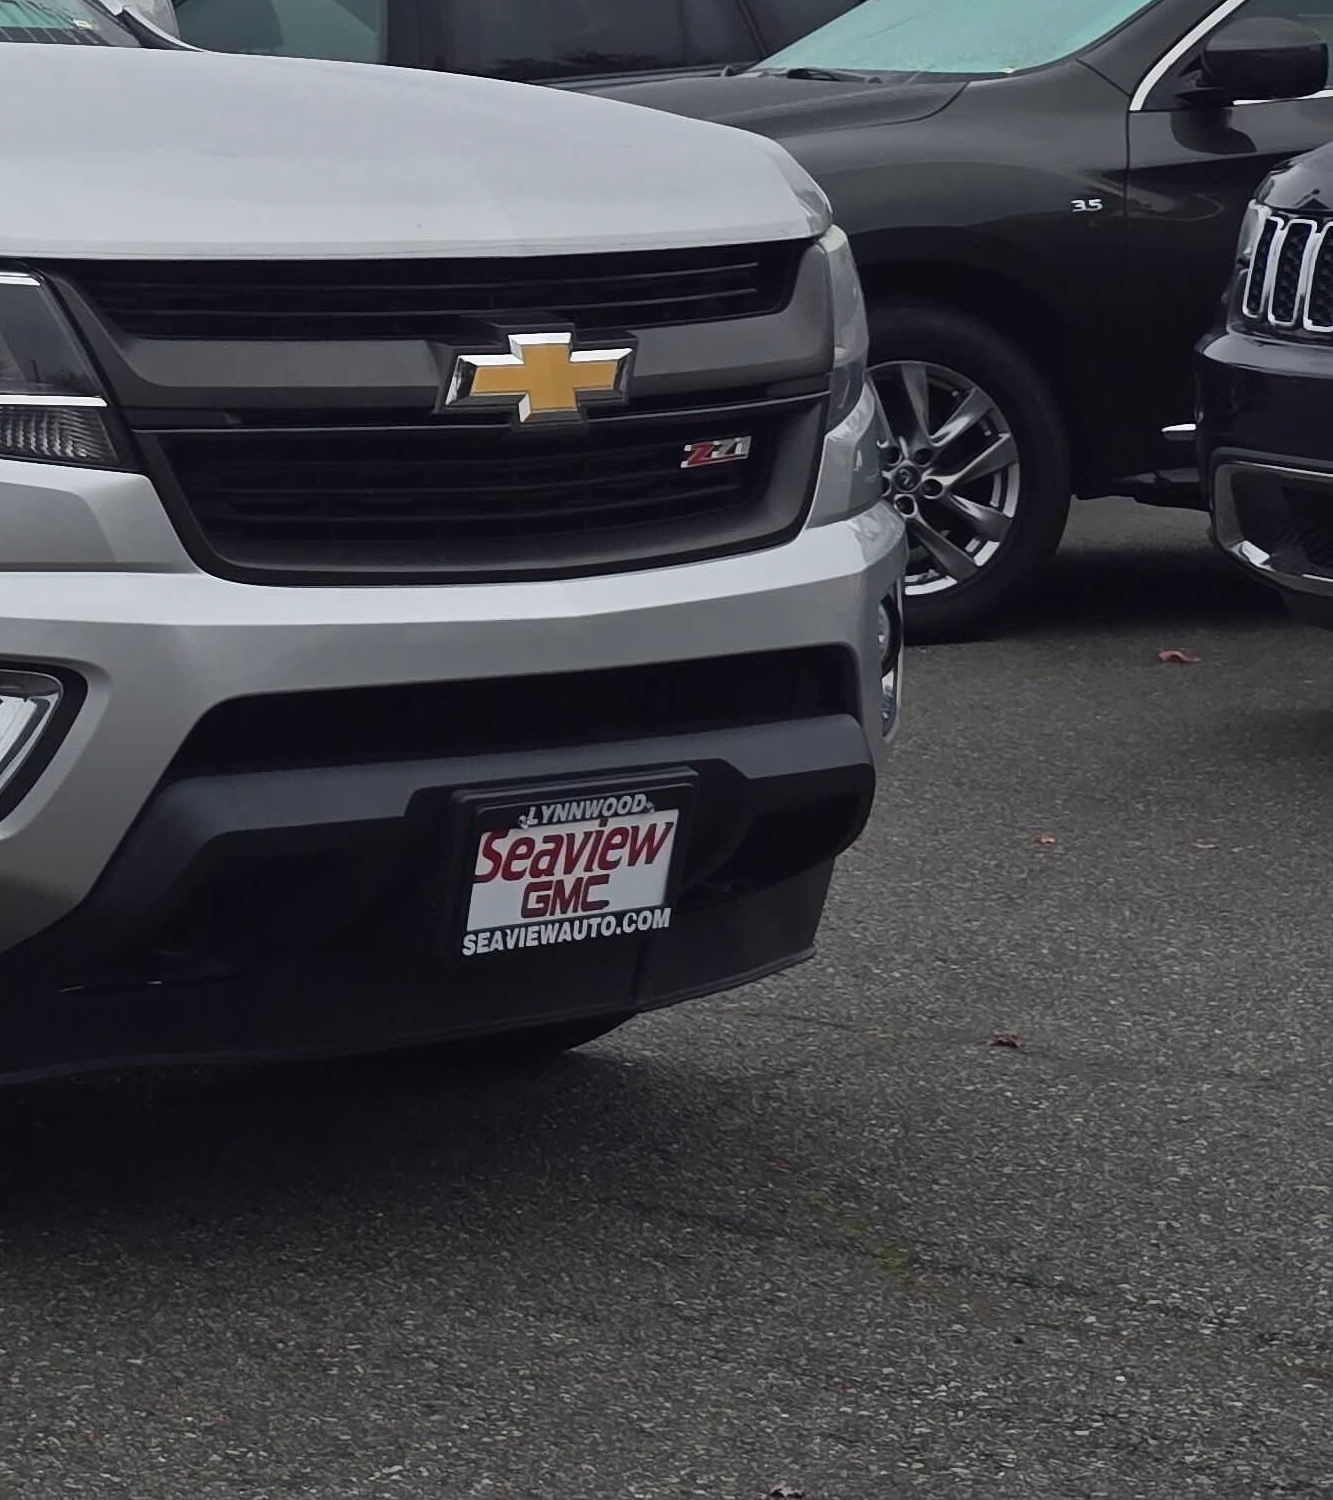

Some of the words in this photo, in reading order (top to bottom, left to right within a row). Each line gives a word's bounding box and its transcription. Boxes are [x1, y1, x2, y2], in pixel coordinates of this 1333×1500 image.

[680, 435, 752, 468] Z71
[527, 793, 647, 826] LYNNWOOD
[473, 817, 675, 883] Seaview
[520, 873, 610, 919] GMC
[462, 907, 672, 957] SEAVIEWAUTO.COM
